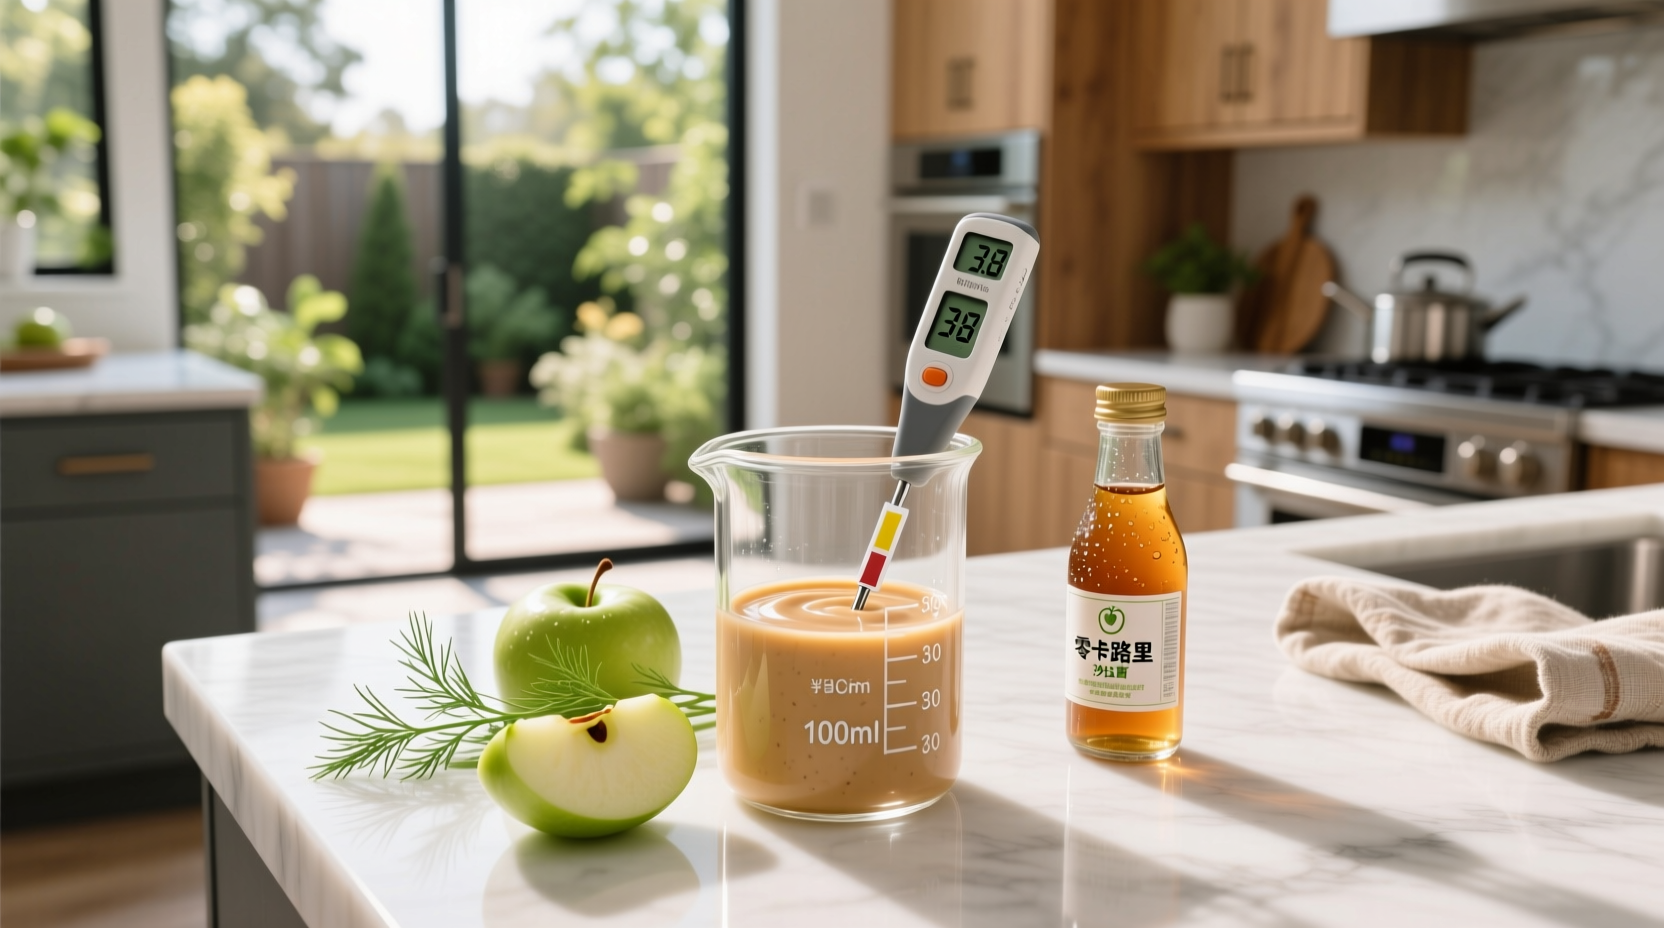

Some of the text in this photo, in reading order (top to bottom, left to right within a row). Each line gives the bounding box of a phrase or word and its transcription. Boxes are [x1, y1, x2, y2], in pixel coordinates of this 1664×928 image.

[968, 244, 1008, 277] 3.8
[938, 306, 981, 344] 38
[922, 643, 941, 664] 30
[1075, 635, 1153, 664] 零卡路里
[921, 688, 941, 710] 30
[804, 719, 879, 745] 100ml
